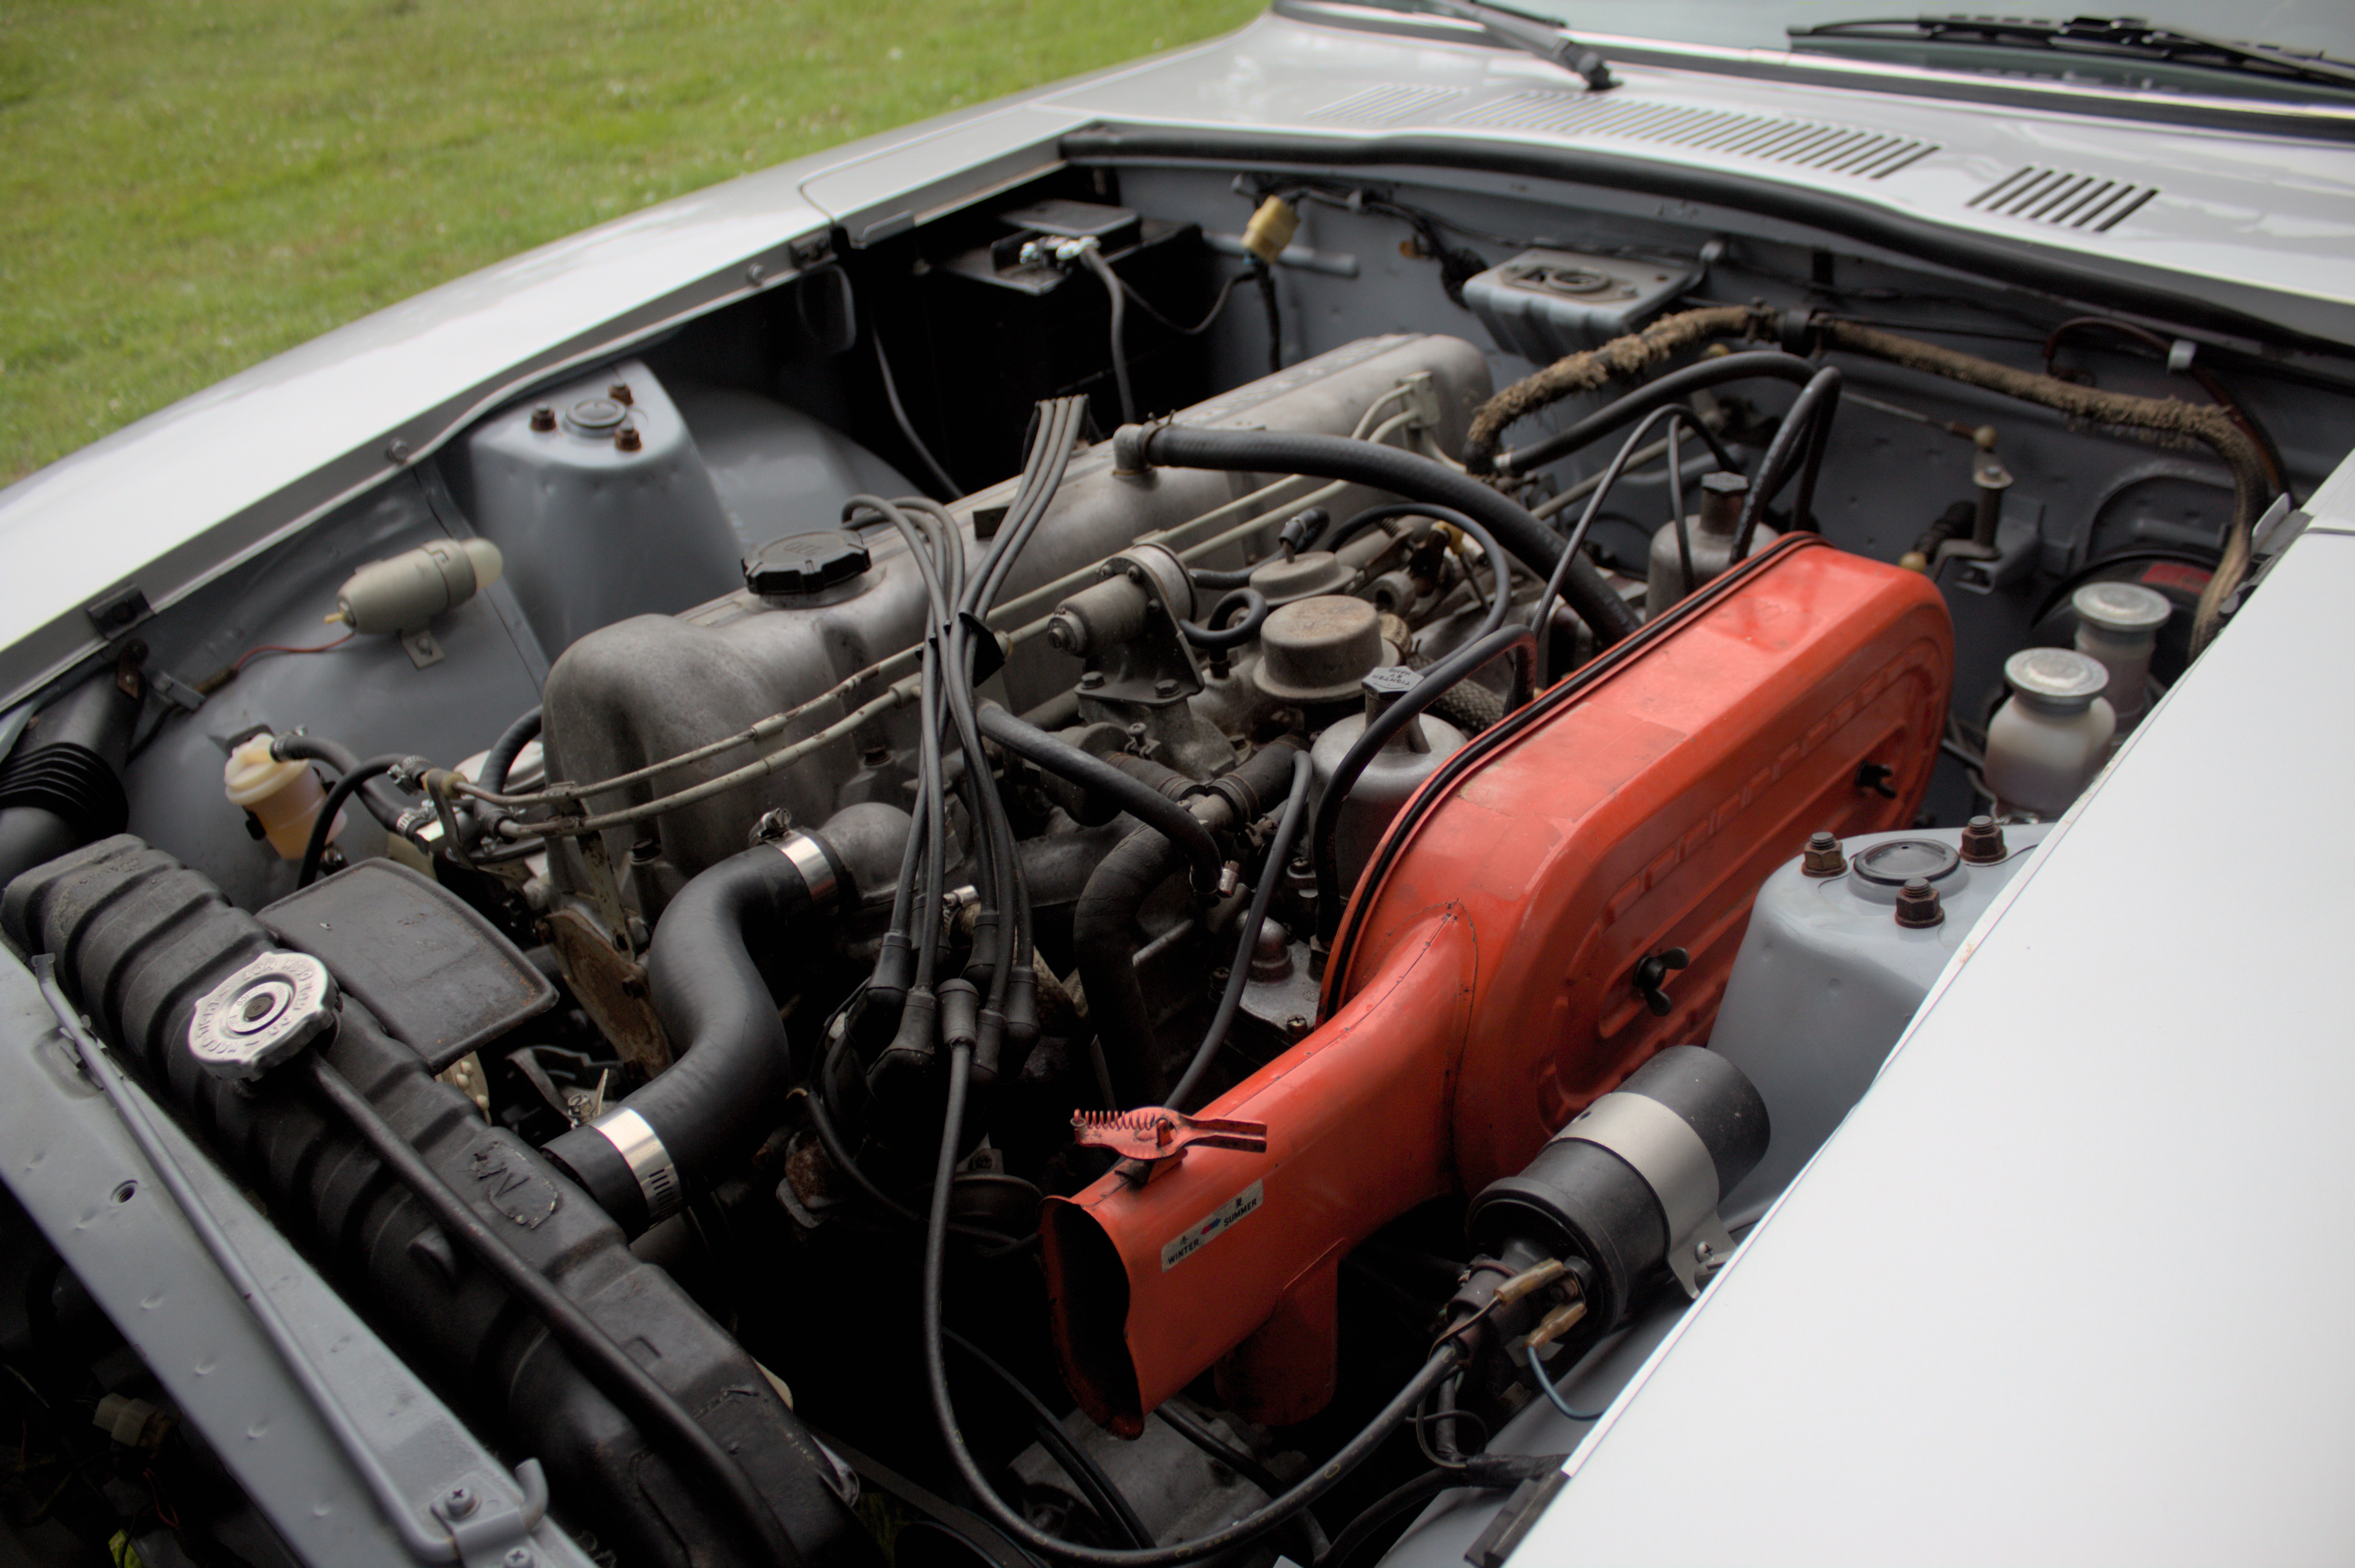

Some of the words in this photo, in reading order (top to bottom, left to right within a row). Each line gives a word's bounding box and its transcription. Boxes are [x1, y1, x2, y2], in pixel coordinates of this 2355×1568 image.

[1371, 674, 1410, 685] TIGHTEN
[243, 961, 276, 981] HOT
[1224, 1198, 1257, 1227] SUMMER
[1179, 1235, 1189, 1245] 冬
[1168, 1238, 1199, 1265] WINTER
